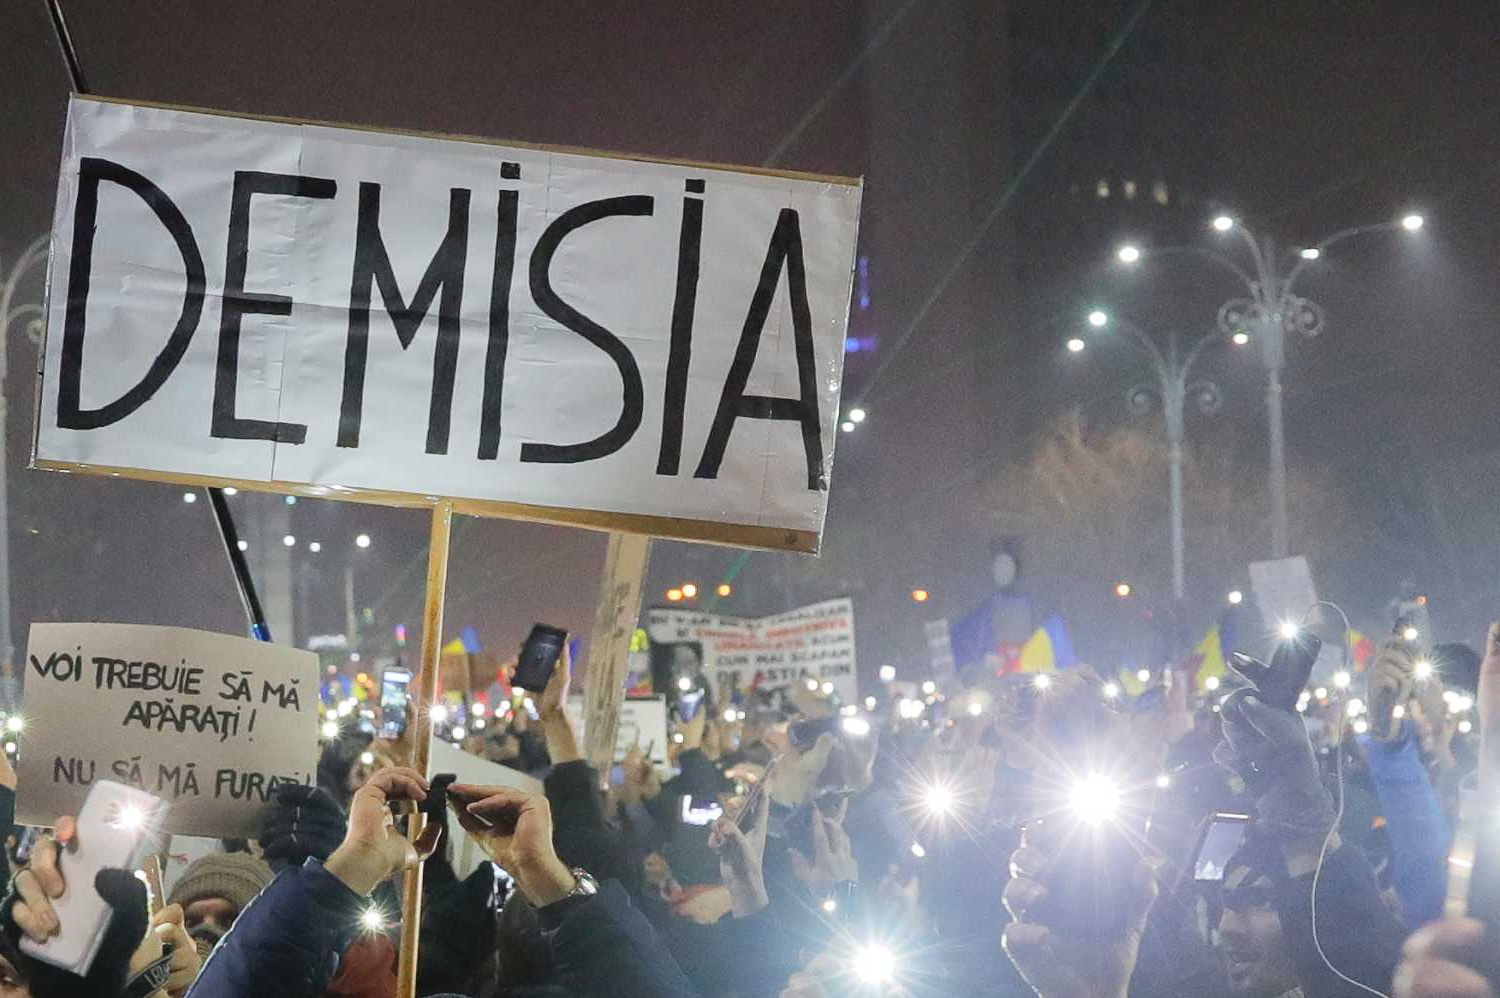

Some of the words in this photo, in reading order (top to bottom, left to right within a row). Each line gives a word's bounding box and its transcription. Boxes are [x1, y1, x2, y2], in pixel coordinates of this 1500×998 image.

[56, 157, 828, 490] DEMISIA
[30, 646, 82, 682] VOI
[91, 657, 204, 695] TREBUIE
[261, 679, 301, 712] MĂ
[54, 756, 96, 786] NU
[158, 763, 200, 798] MĂ
[215, 768, 311, 802] FURA
